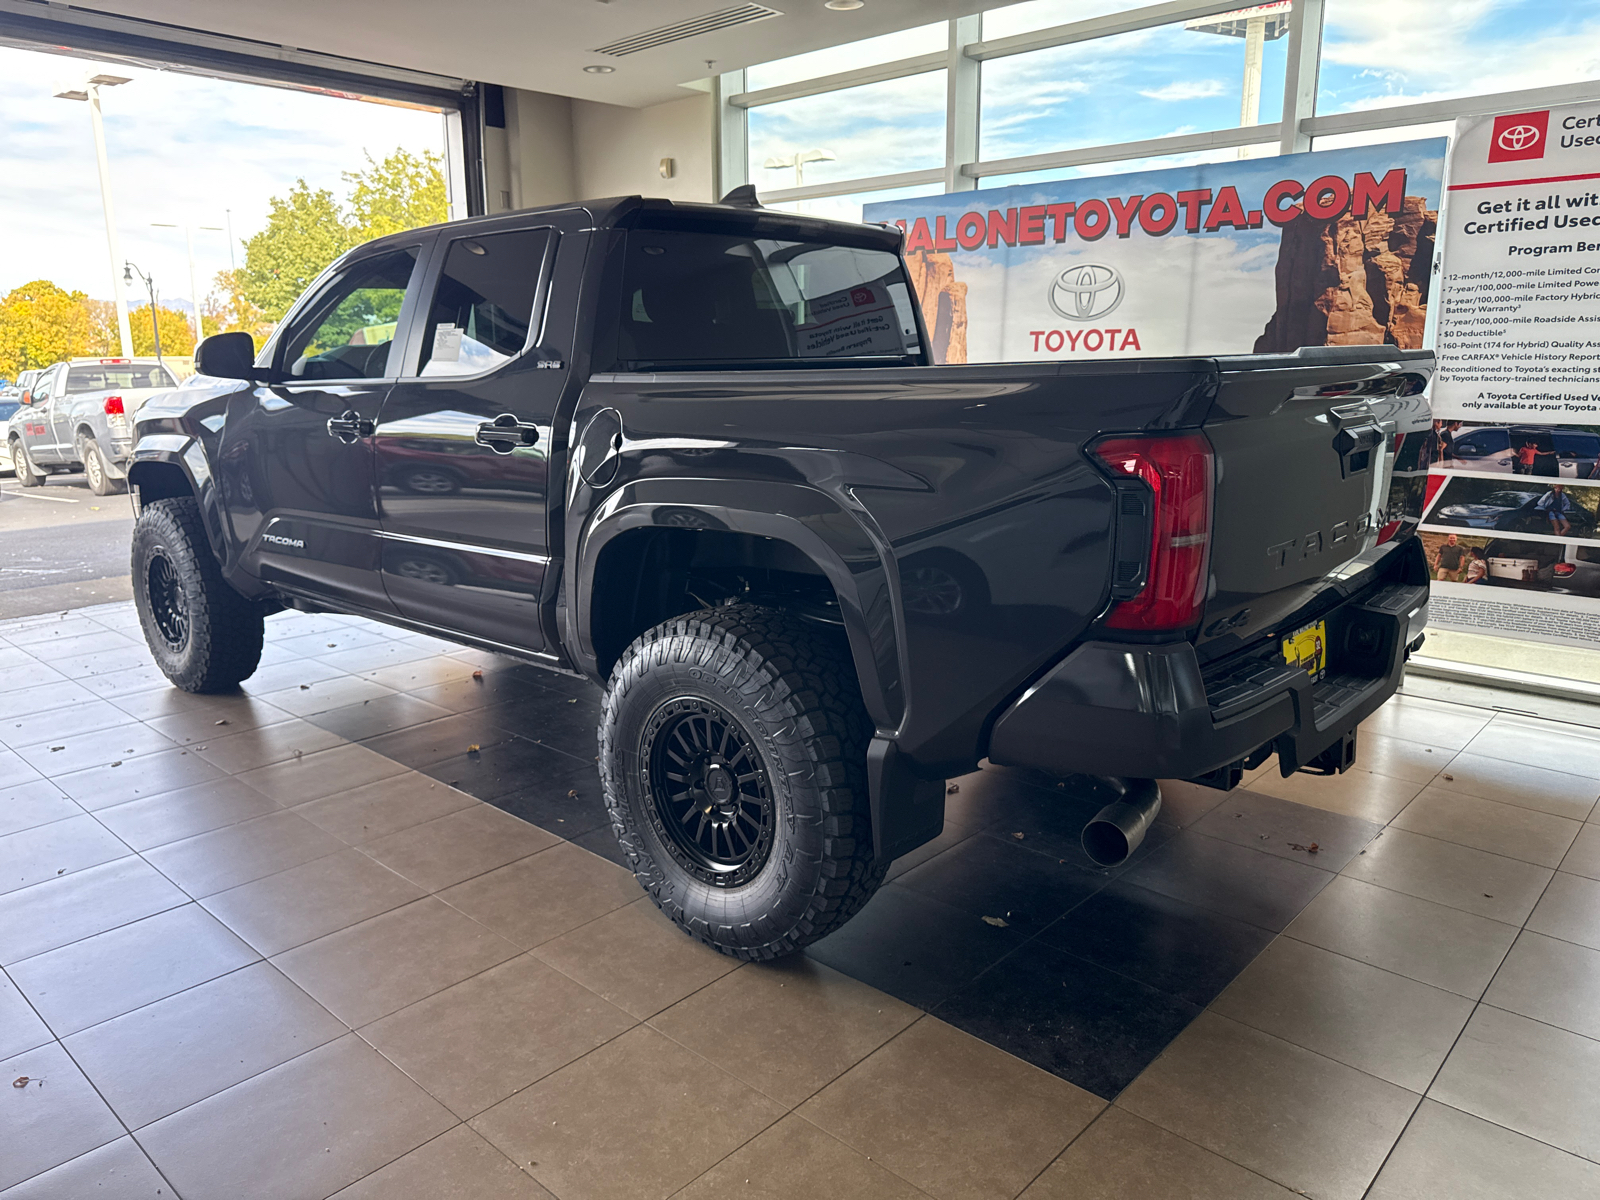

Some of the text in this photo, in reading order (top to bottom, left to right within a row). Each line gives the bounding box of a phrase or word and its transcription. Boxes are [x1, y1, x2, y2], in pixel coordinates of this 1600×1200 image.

[1477, 192, 1600, 215] Get it all wit
[880, 168, 1407, 257] ALONETOYOTA.COM
[1464, 216, 1549, 235] Certified
[1508, 244, 1572, 257] Program
[1449, 270, 1546, 281] 12-month/12,000-mile
[1547, 267, 1582, 276] Limited
[1447, 279, 1600, 294] 7-year/100,000-mile Limited Powe
[1446, 294, 1534, 305] 8-year/100,000-mile
[1535, 293, 1568, 303] Factory
[1445, 307, 1477, 315] Battery
[1444, 316, 1532, 327] 7-year/100,000-mile
[1443, 330, 1455, 338] $0
[1029, 328, 1141, 353] TOYOTA
[1516, 341, 1549, 349] Hybrid)
[1551, 341, 1584, 349] Quality
[1534, 354, 1567, 362] History
[1569, 354, 1600, 362] Report
[1551, 366, 1591, 375] exacting
[1451, 375, 1479, 383] Toyota
[1481, 375, 1547, 383] factory-trained
[1486, 393, 1518, 401] Toyota
[1519, 393, 1562, 401] Certified
[1461, 401, 1482, 410] only
[1483, 402, 1526, 410] available
[1539, 404, 1563, 412] your
[1563, 404, 1597, 413] Toyota
[262, 533, 305, 548] TACOMA
